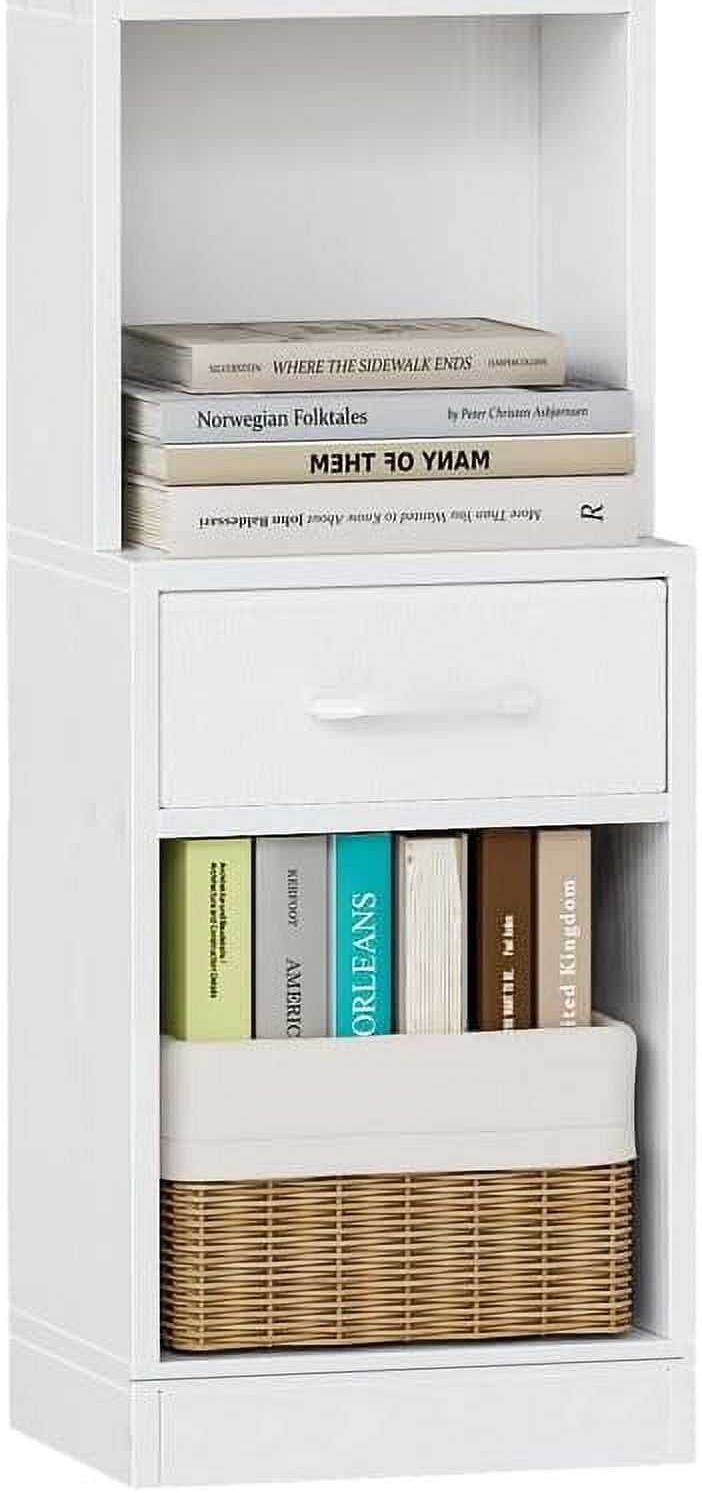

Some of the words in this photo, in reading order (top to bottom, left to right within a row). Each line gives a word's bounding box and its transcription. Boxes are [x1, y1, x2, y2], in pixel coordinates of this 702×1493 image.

[273, 359, 325, 375] WHERE
[329, 359, 358, 374] THE
[357, 357, 432, 374] SIDEWALK
[434, 356, 473, 371] ENDS
[197, 410, 288, 431] Norwegian
[294, 407, 368, 426] Folktales
[448, 407, 458, 422] by
[461, 407, 486, 420] Peter
[383, 512, 397, 524] to
[400, 510, 446, 524] Wanted
[475, 509, 507, 522] Than
[511, 508, 543, 521] More
[580, 504, 604, 521] R
[198, 515, 269, 529] Baldessari
[272, 514, 303, 527] John
[560, 879, 581, 975] Kingdom
[352, 891, 376, 1036] ORLEANS
